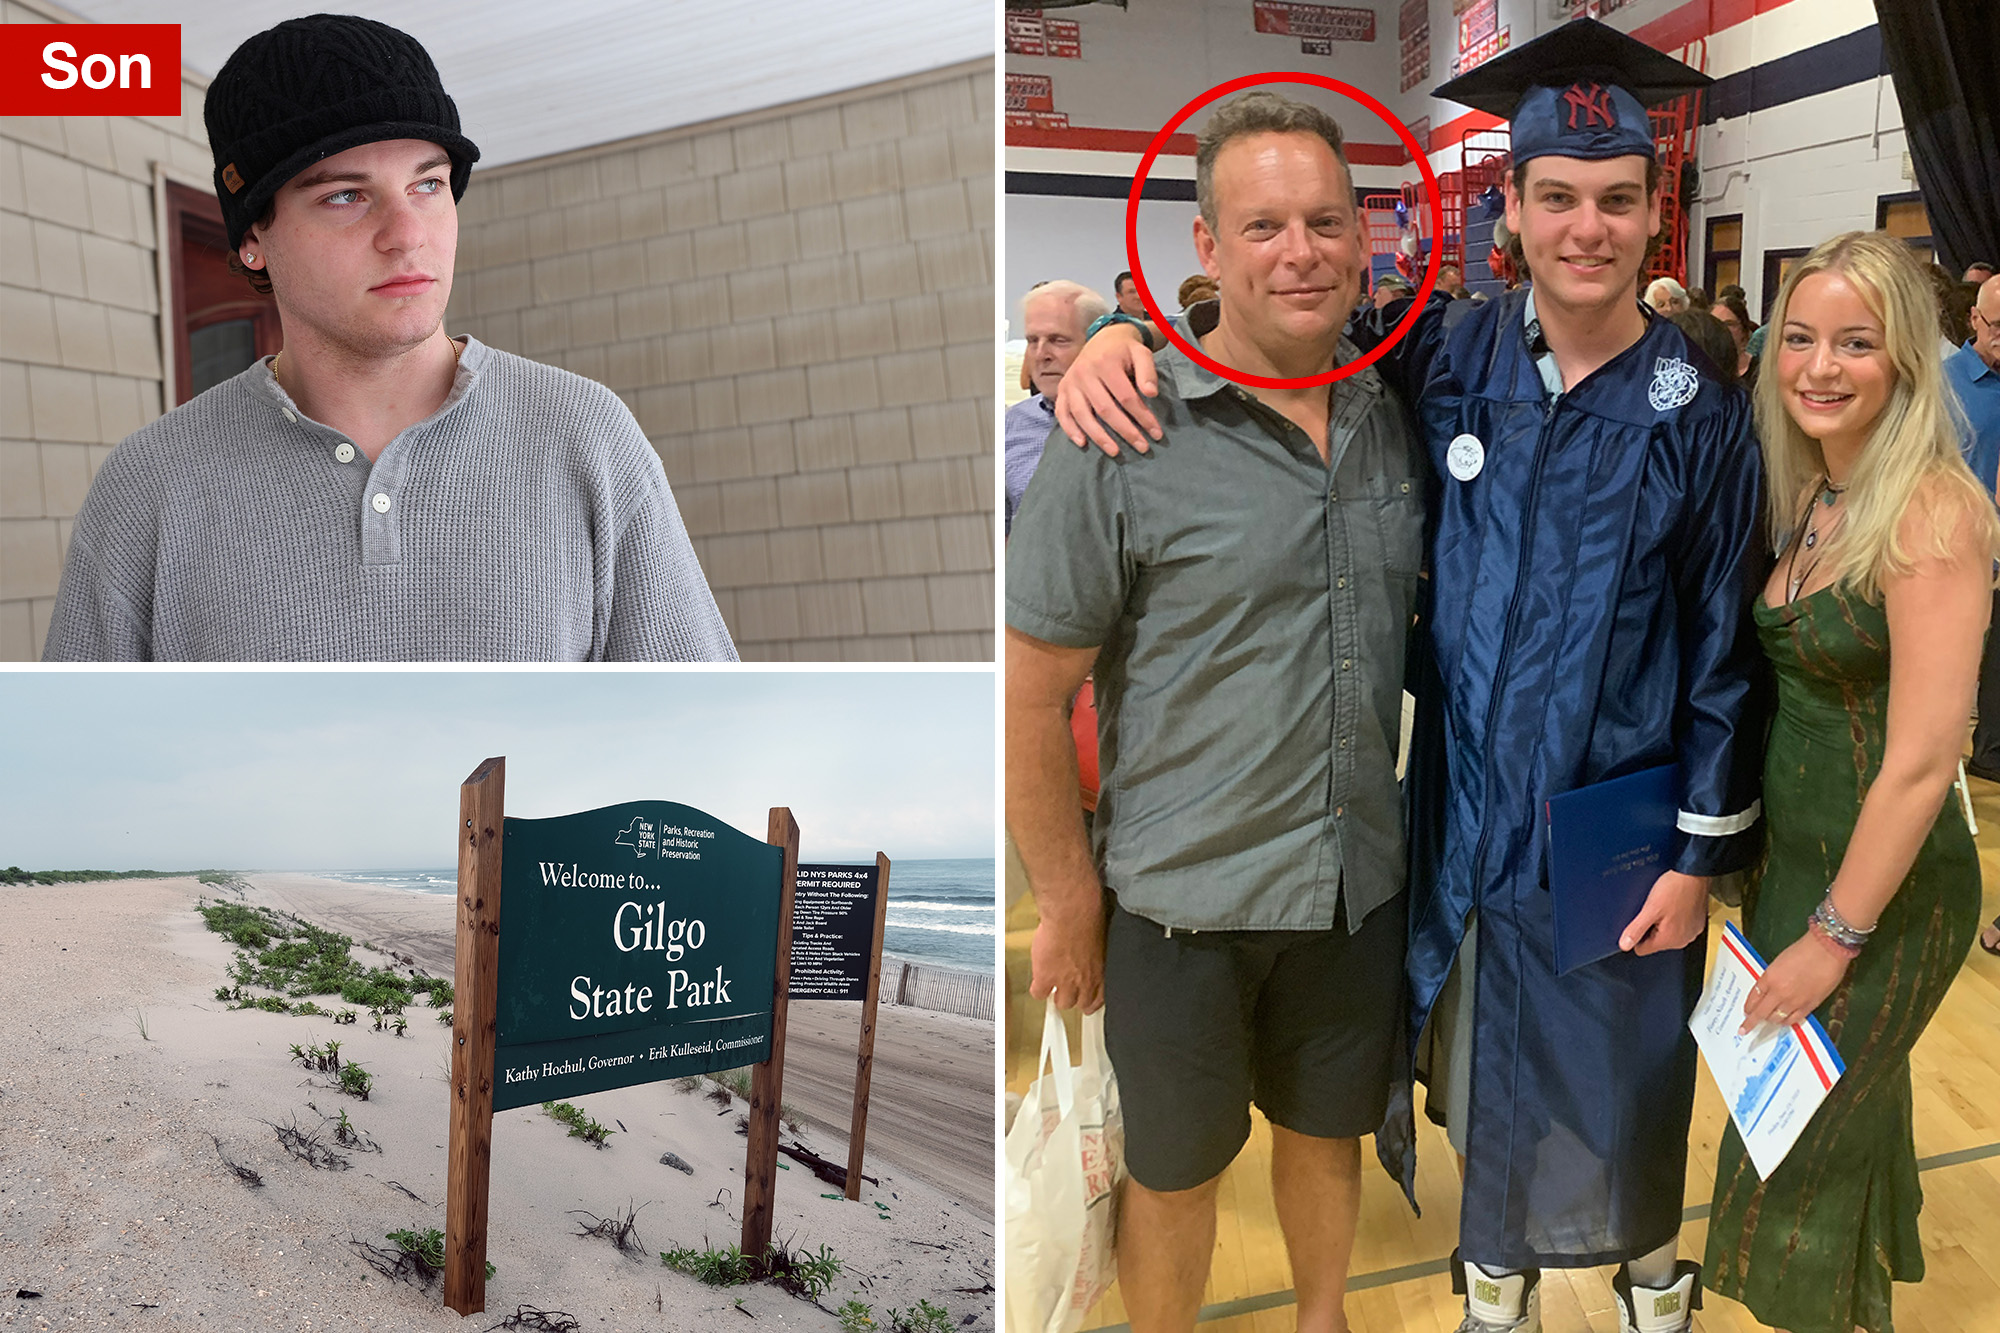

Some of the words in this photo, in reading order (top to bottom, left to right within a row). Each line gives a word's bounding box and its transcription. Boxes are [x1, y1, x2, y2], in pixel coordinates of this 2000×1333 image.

[639, 822, 654, 831] NEW
[663, 824, 683, 837] Parks,
[683, 826, 715, 839] Recreation
[638, 831, 655, 840] YORK
[638, 840, 656, 849] STATE
[662, 837, 674, 847] and
[675, 838, 699, 849] Historic
[661, 848, 701, 861] Preservation
[539, 862, 625, 889] Welcome
[629, 872, 661, 890] to...
[822, 881, 861, 889] REQUIRED
[613, 900, 706, 962] Gilgo
[802, 932, 814, 940] Tips
[569, 975, 653, 1021] State
[666, 965, 732, 1010] Park
[505, 1067, 539, 1084] Kathy
[542, 1057, 586, 1078] Hochul,
[588, 1054, 635, 1070] Governor
[649, 1047, 668, 1061] Erik
[670, 1041, 714, 1058] Kulleseid,
[716, 1034, 765, 1052] Commissioner
